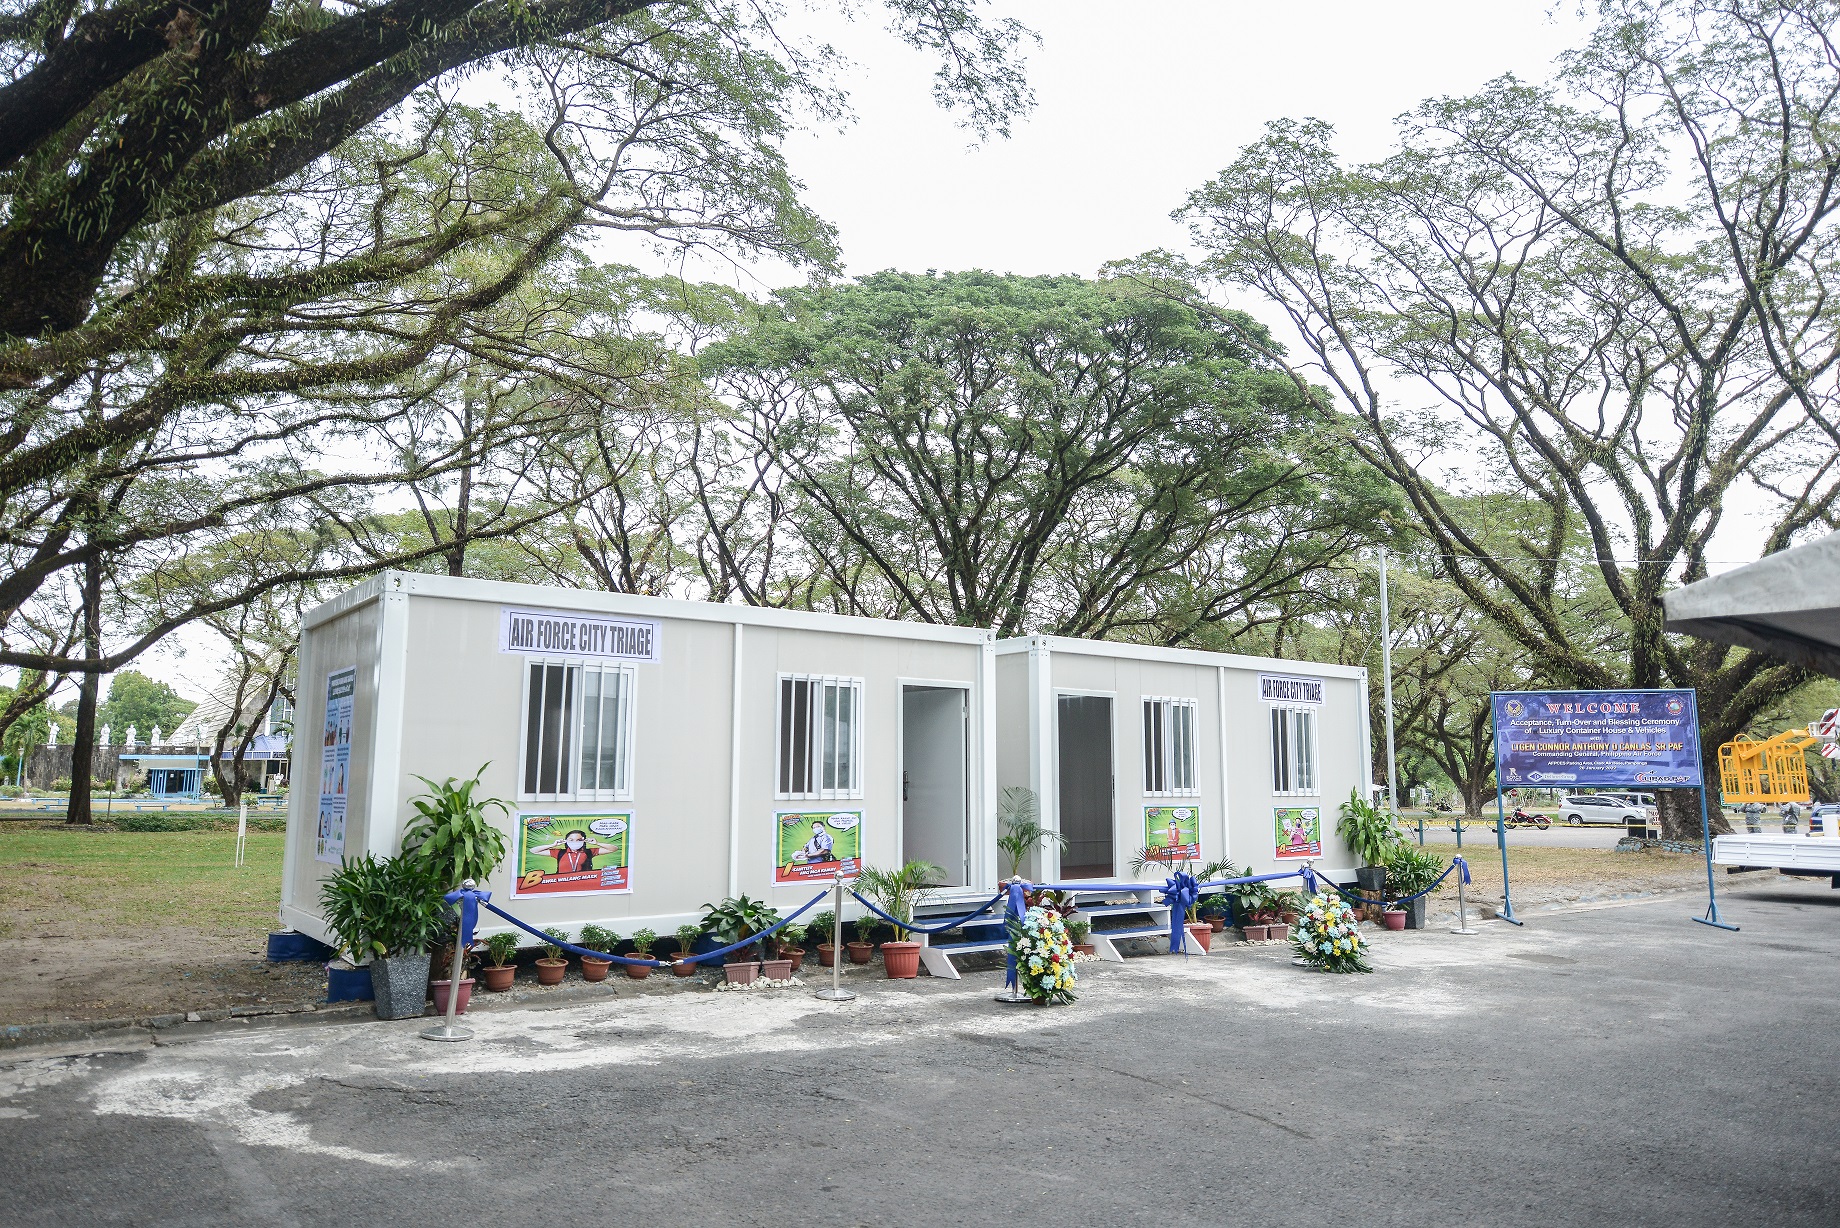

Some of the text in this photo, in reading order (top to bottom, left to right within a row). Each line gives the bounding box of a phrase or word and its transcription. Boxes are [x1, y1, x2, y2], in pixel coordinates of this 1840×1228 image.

[511, 618, 651, 655] AIR FORCE CITY TRIAGE
[1262, 679, 1321, 702] AIR FORCE CITY TRIAGE
[1546, 703, 1640, 714] WELCOME
[1510, 719, 1554, 727] Acceptance,
[1608, 719, 1640, 727] Blessing
[1641, 719, 1680, 727] Ceremony
[1511, 743, 1535, 752] LTGEN
[1537, 743, 1570, 752] CONNOR
[1572, 743, 1610, 752] ANTHONY
[1620, 743, 1652, 752] CANLAS
[1655, 743, 1667, 752] SR
[1668, 743, 1683, 751] PAF
